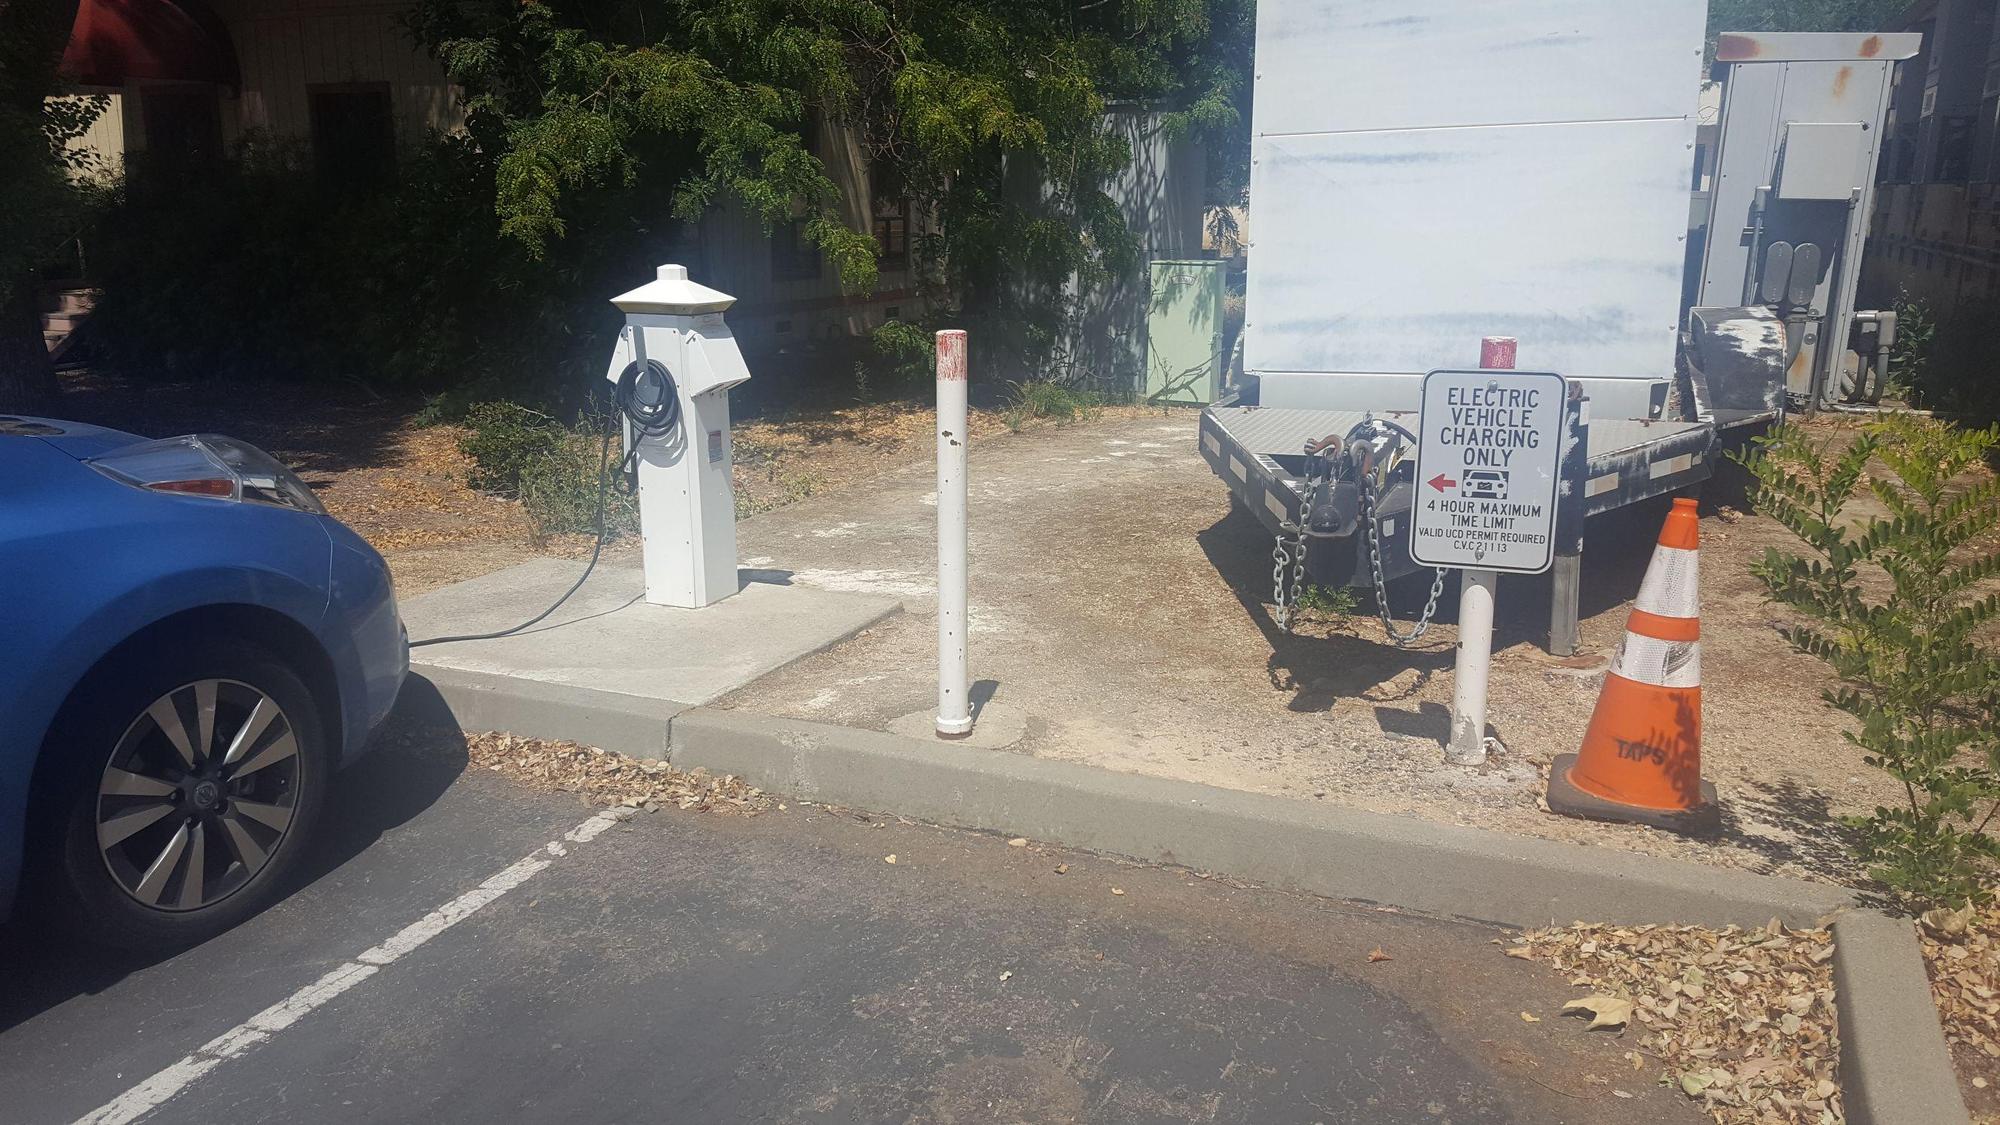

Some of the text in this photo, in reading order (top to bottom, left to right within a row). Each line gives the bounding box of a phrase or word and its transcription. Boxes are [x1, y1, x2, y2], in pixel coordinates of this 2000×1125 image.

[1447, 387, 1540, 408] ELECTRIC
[1451, 407, 1533, 428] VEHICLE
[1440, 427, 1539, 449] CHARGING
[1463, 447, 1513, 467] ONLY
[1427, 499, 1541, 518] 4 HOUR MAXIMUM
[1450, 514, 1515, 530] TIME LIMIT
[1418, 527, 1546, 545] VALID UCD PERMIT REQUIRED
[1615, 738, 1665, 766] TAPS
